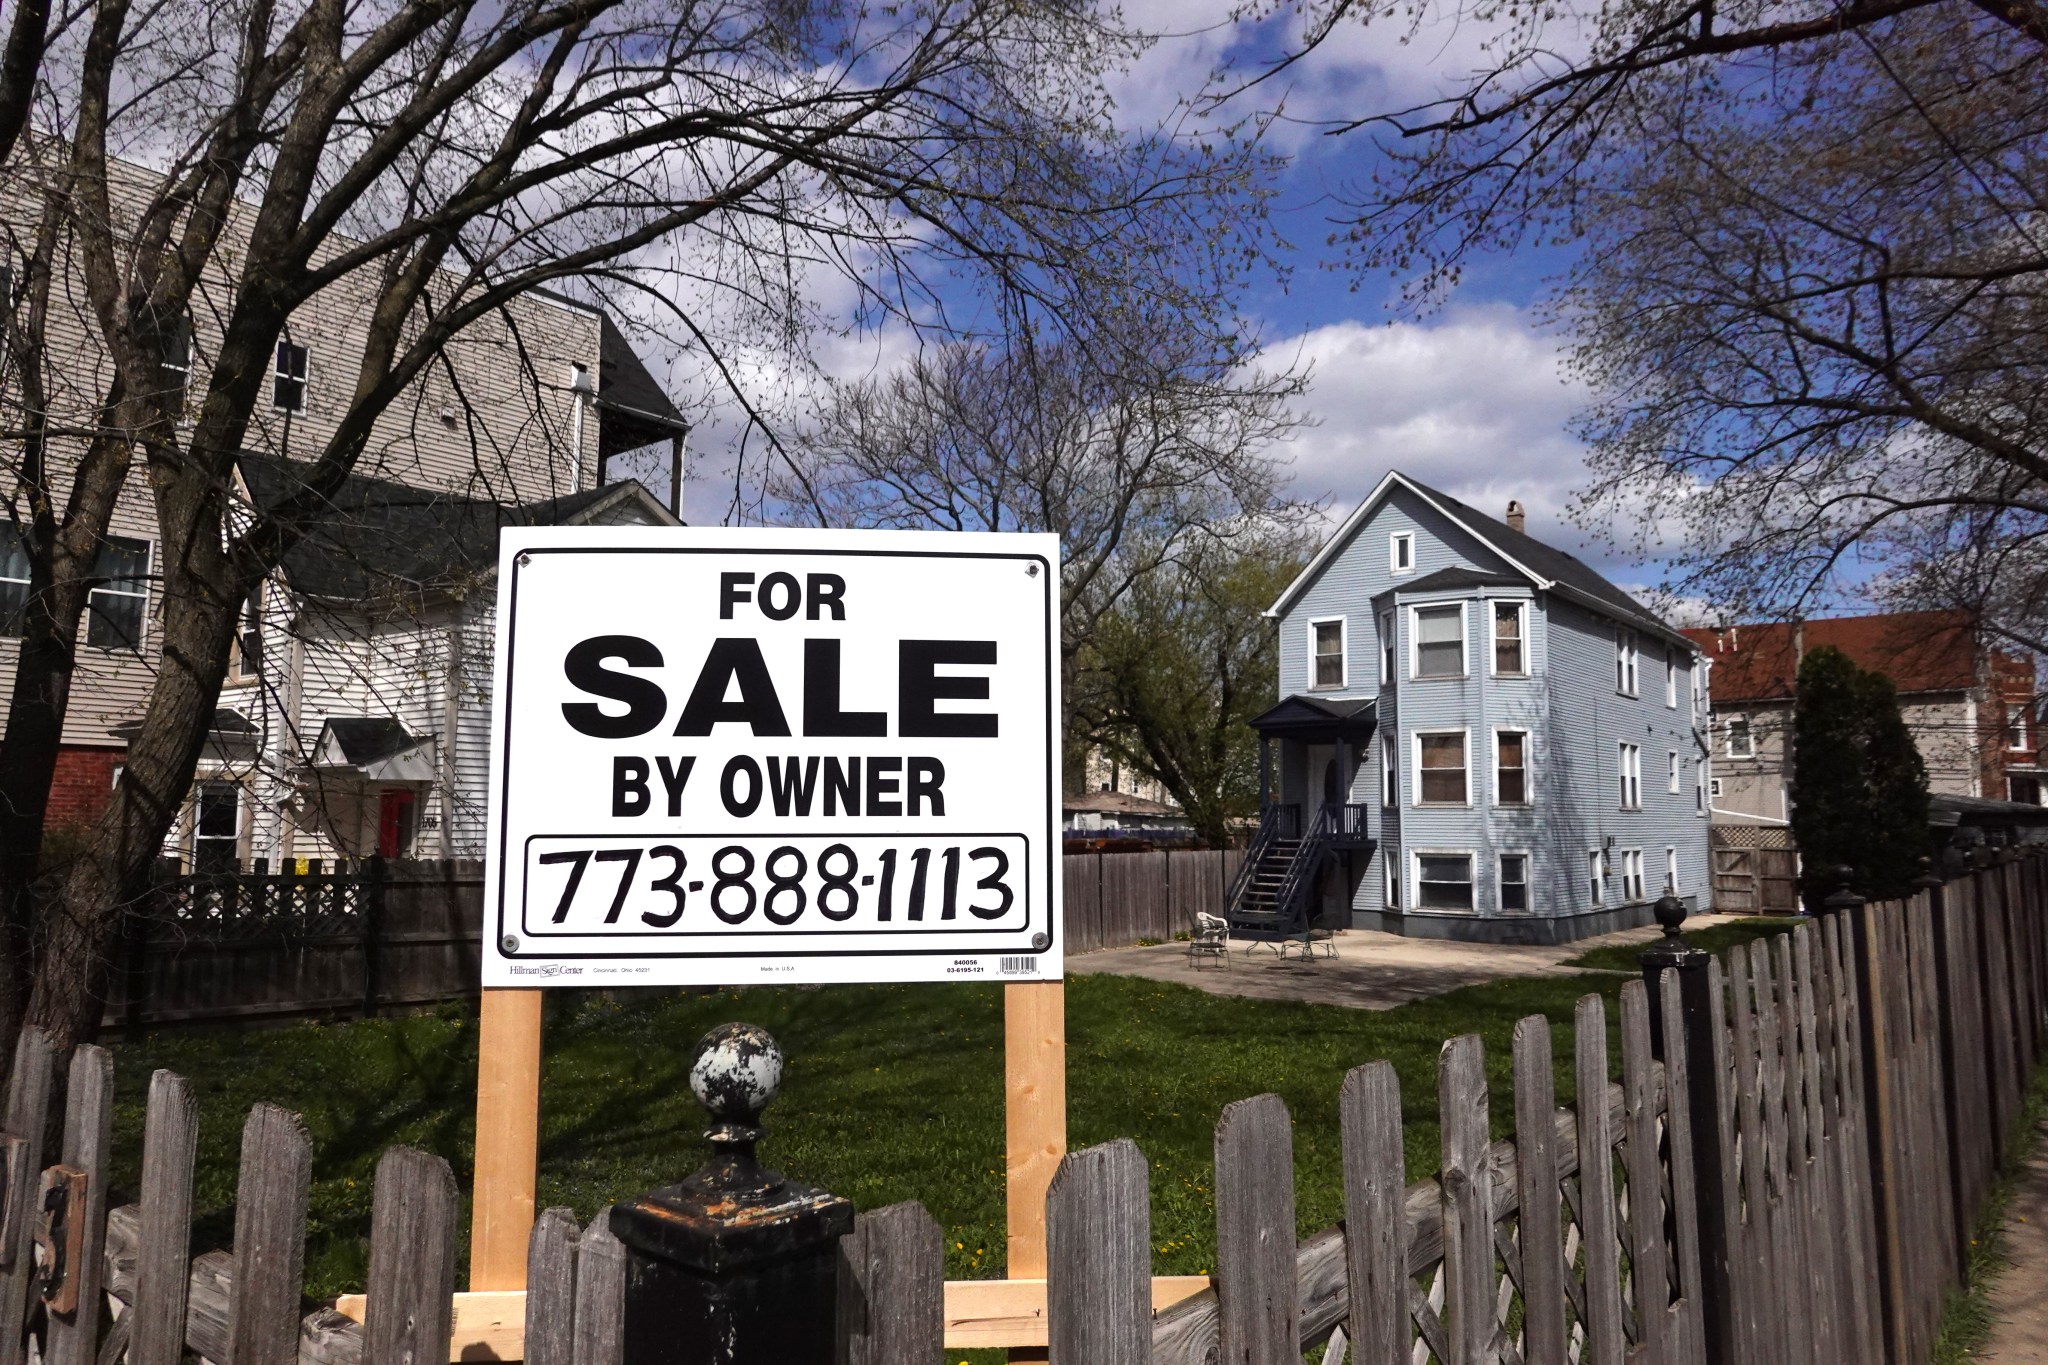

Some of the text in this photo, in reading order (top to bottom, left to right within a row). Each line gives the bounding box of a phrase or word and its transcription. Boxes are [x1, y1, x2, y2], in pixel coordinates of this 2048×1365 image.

[720, 572, 846, 621] FOR
[562, 635, 998, 740] SALE
[612, 755, 945, 818] BY OWNER
[539, 843, 1013, 928] 773-888-1113
[509, 965, 584, 975] Hillman Sign Center
